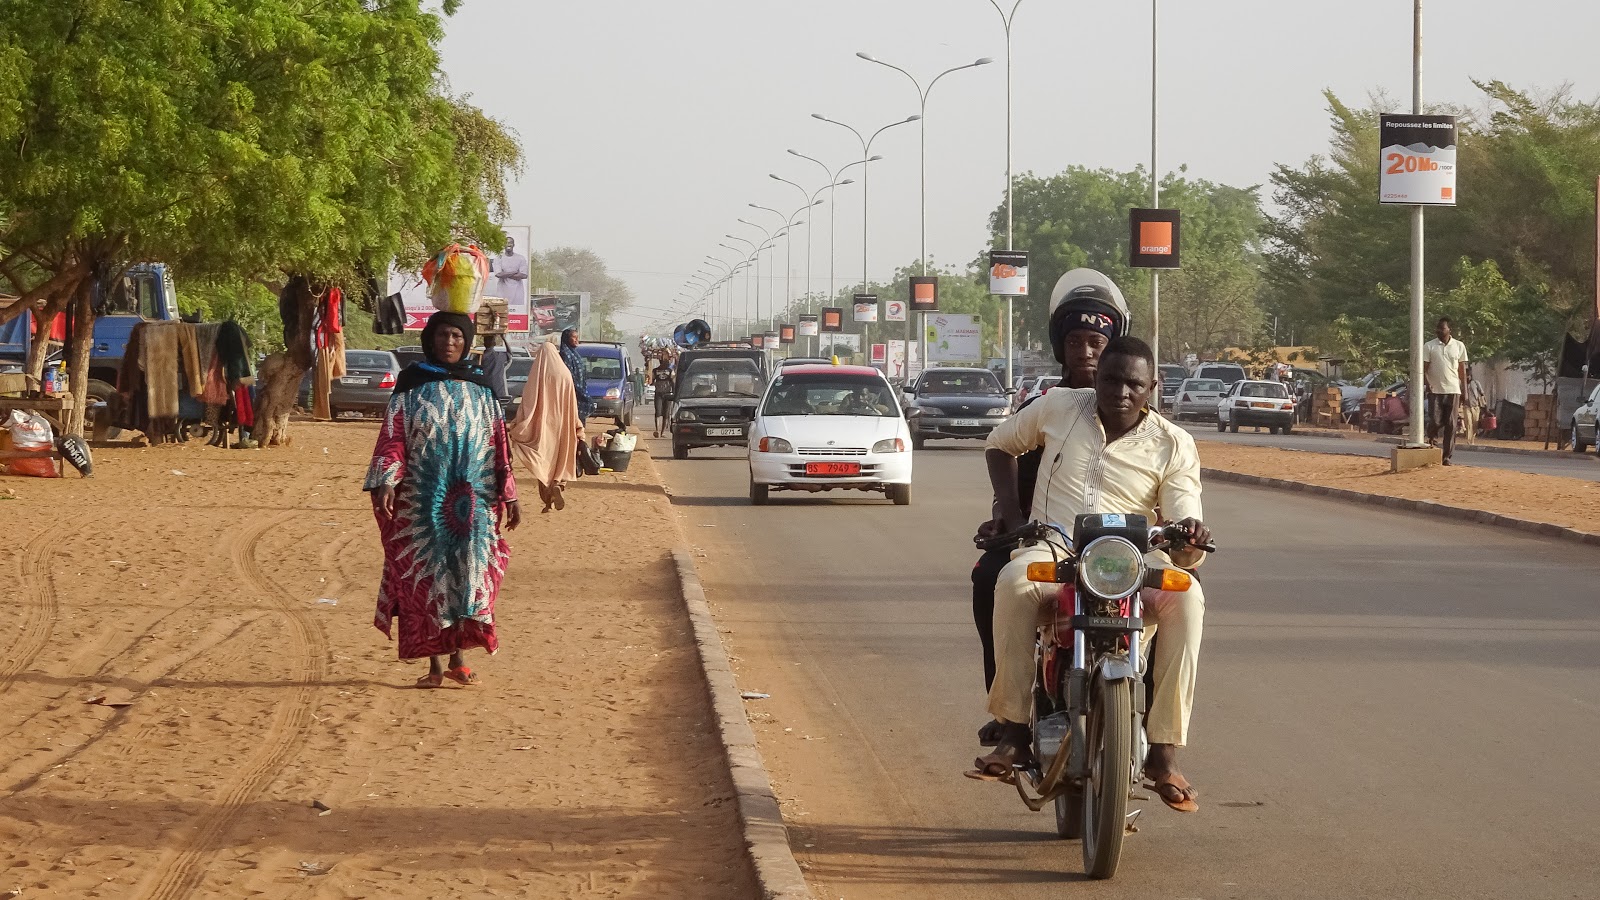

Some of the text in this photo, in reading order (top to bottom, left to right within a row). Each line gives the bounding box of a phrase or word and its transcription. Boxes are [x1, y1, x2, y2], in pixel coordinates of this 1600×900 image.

[1385, 121, 1422, 129] Repoussez
[1141, 246, 1168, 254] orange
[1081, 313, 1108, 328] NY
[827, 464, 849, 473] 7949
